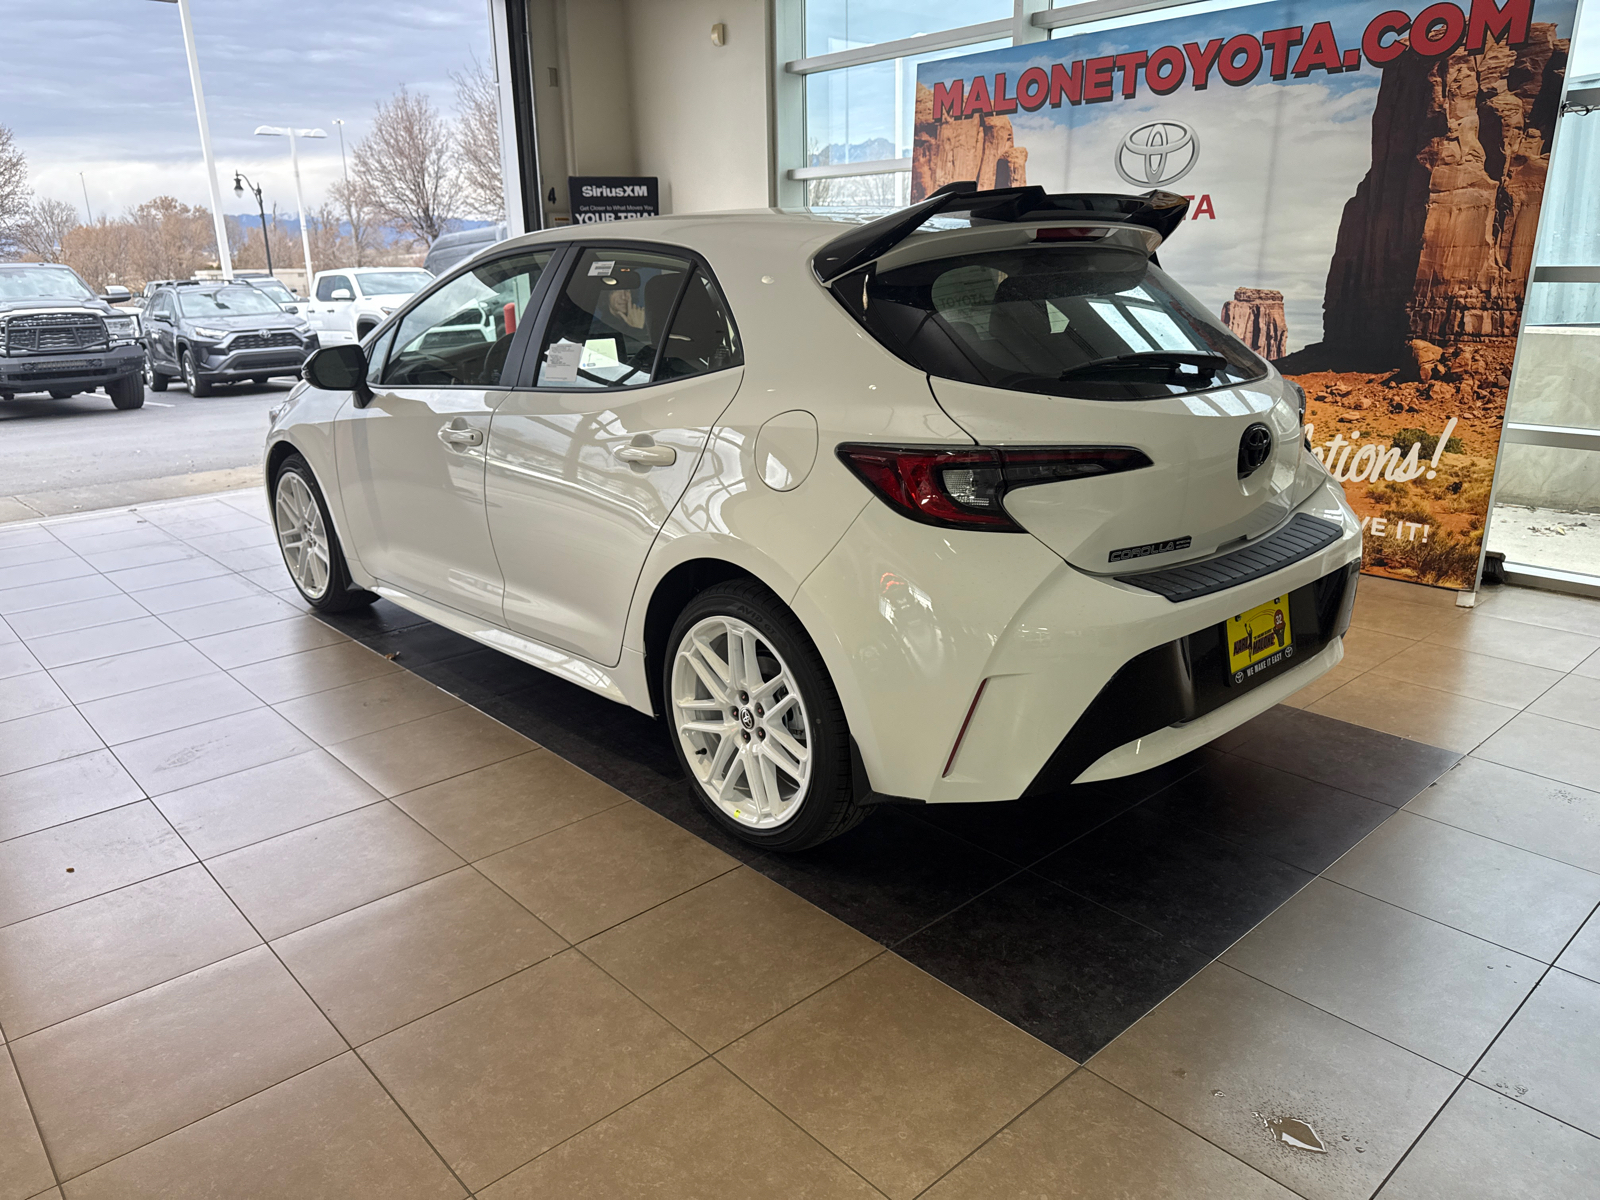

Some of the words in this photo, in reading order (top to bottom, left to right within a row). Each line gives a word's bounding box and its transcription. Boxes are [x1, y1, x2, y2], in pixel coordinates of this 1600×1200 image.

[932, 0, 1533, 122] MALONETOYOTA.COM
[548, 187, 556, 204] 4
[581, 185, 648, 198] SiriusXM
[575, 212, 616, 225] YOUR
[1396, 520, 1430, 543] IT!
[1110, 541, 1175, 562] COROLLA
[737, 605, 763, 622] AVID
[1275, 614, 1283, 625] 32
[1246, 667, 1254, 677] WE
[1254, 660, 1267, 674] MAKE
[1266, 657, 1272, 667] IT
[1271, 652, 1282, 665] EASY
